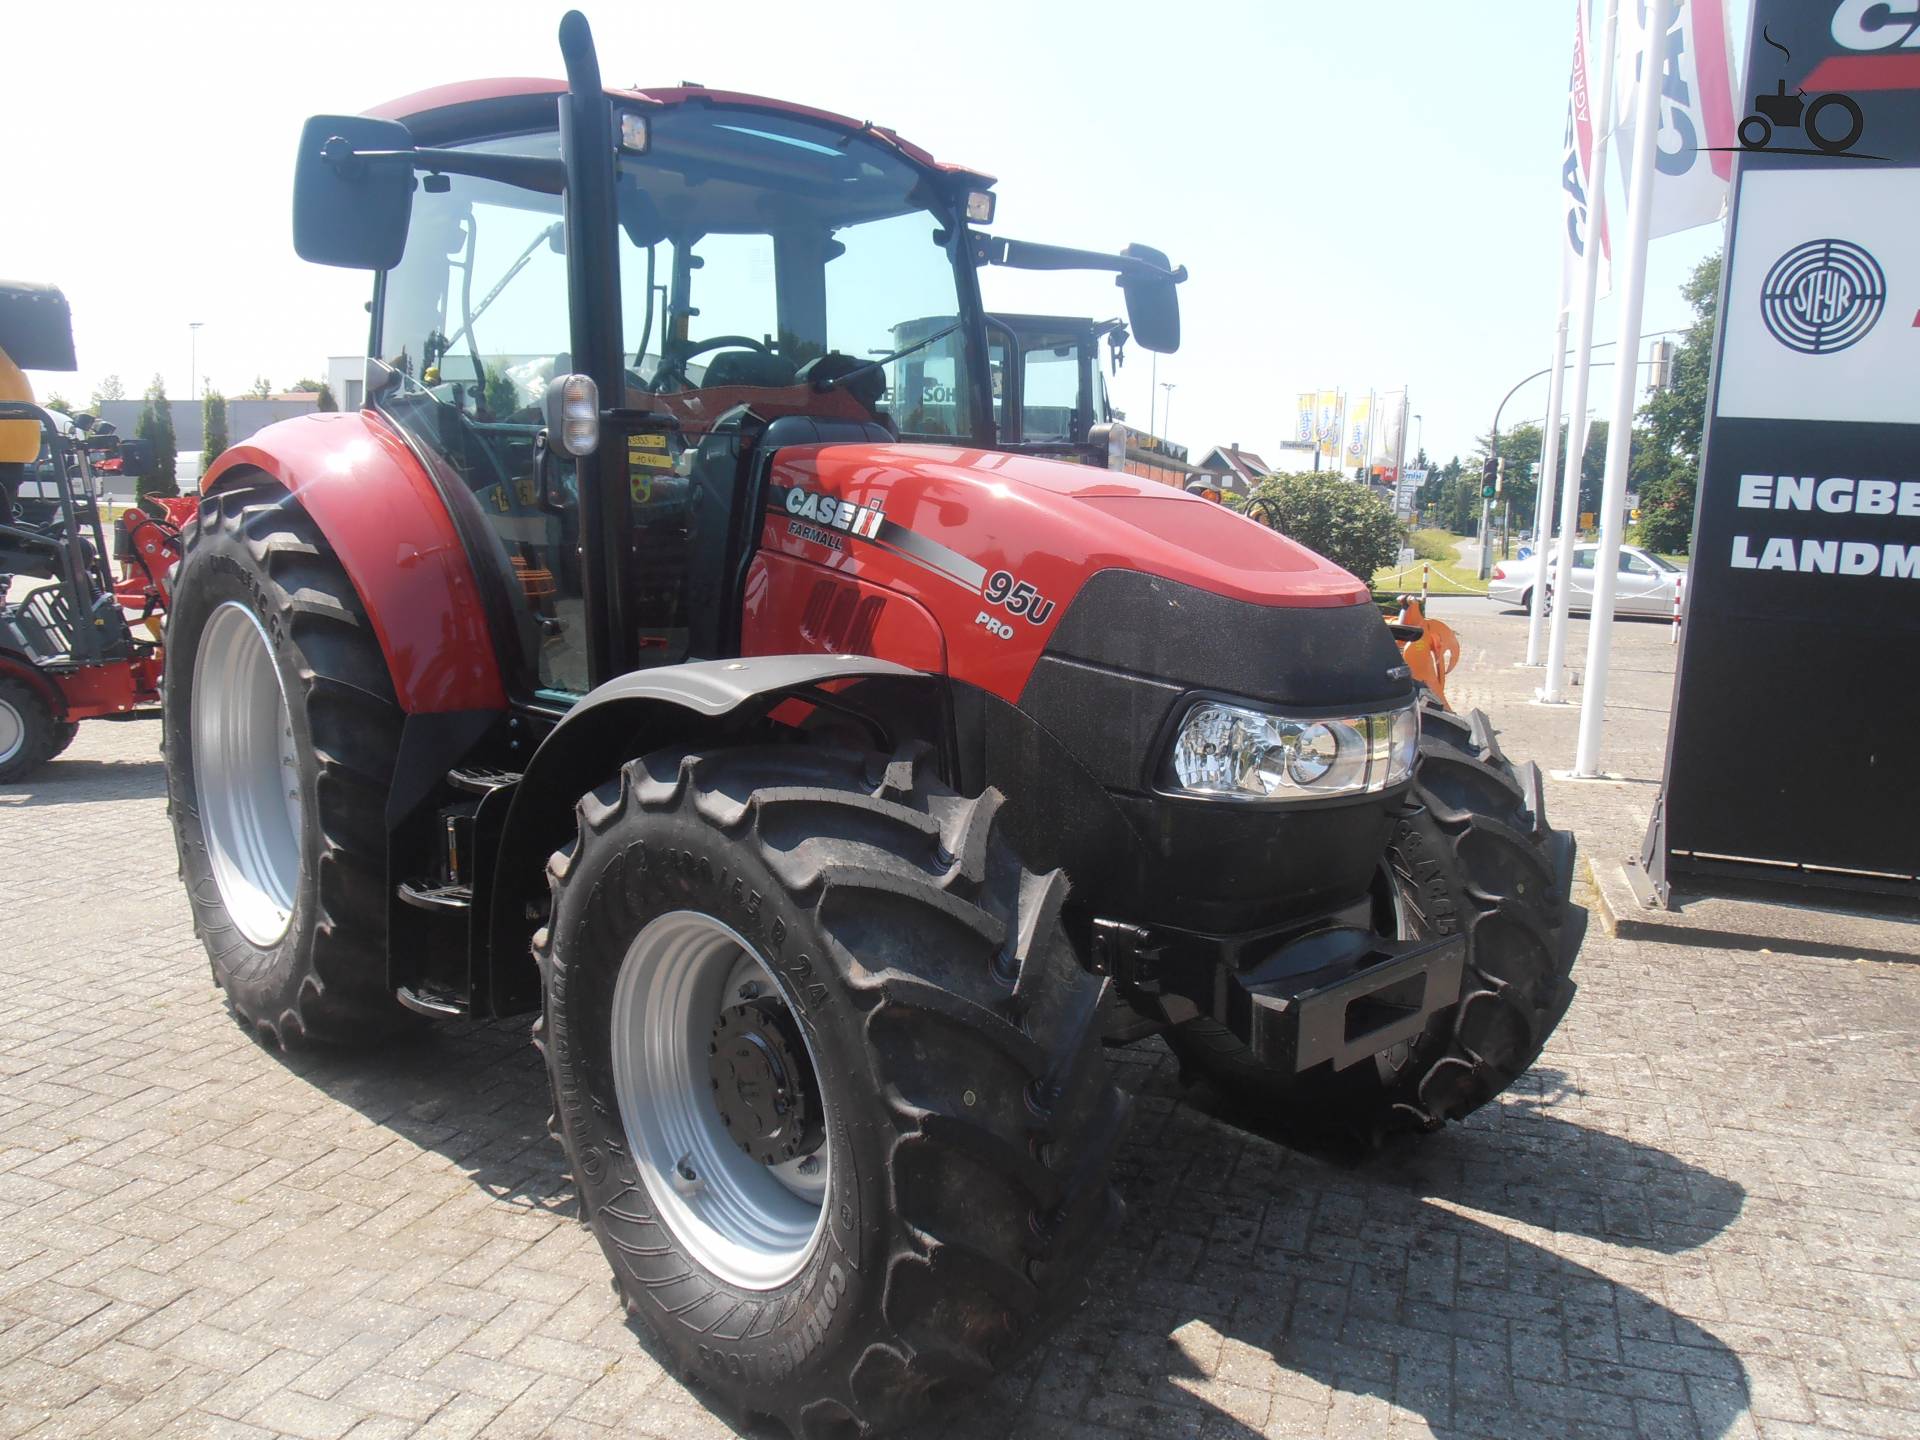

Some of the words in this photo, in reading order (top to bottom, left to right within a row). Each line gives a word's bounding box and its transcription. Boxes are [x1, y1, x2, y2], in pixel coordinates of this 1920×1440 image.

[1793, 268, 1851, 324] STEYR
[785, 487, 858, 531] CASE
[1737, 474, 1920, 517] ENGBE
[787, 521, 843, 550] FARMALL
[1730, 536, 1920, 580] LANDM
[983, 570, 1056, 626] 95U
[975, 611, 1014, 641] PRO
